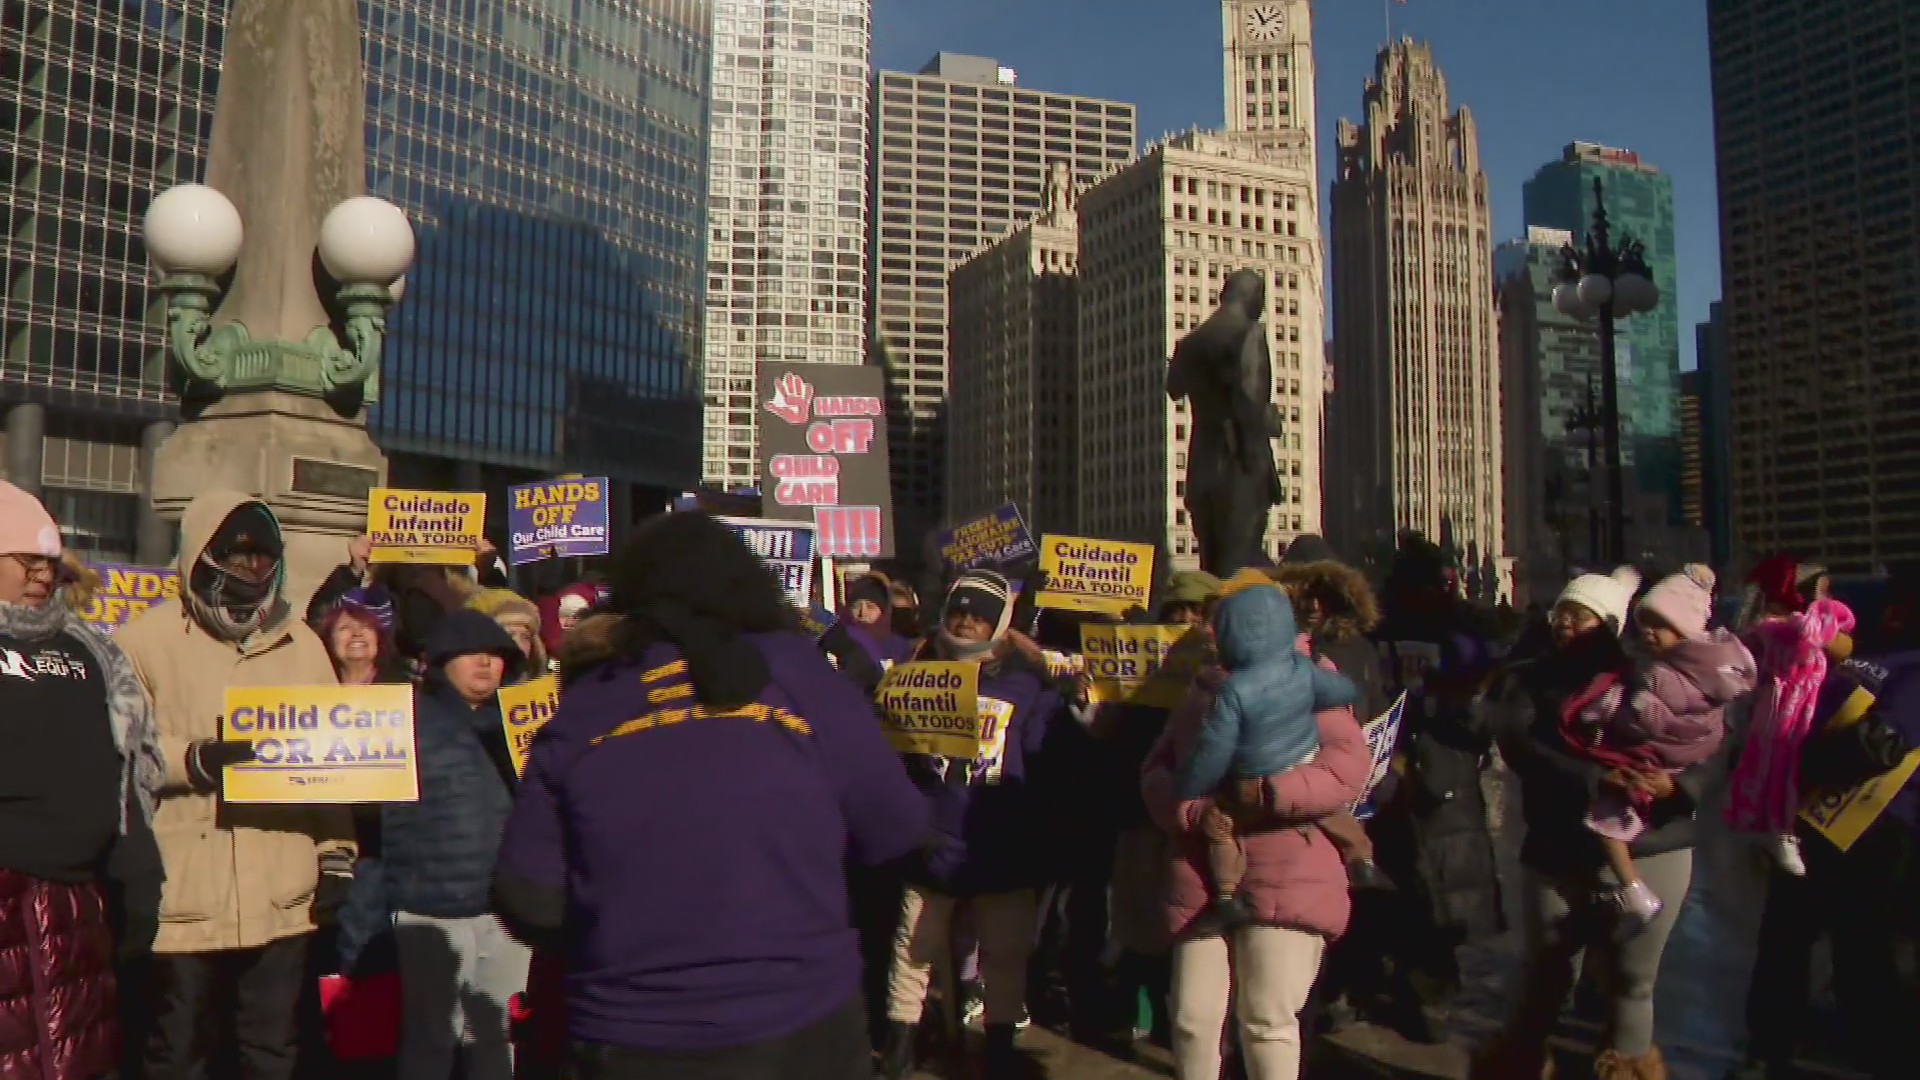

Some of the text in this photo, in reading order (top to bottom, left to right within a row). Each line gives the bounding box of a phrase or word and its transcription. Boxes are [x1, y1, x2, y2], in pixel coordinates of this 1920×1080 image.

[814, 397, 881, 416] HANDS
[806, 419, 874, 453] OFF
[770, 455, 839, 478] CHILD
[515, 483, 599, 509] HANDS
[775, 481, 838, 505] CARE
[384, 494, 471, 514] Cuidado
[389, 514, 463, 532] Infantil
[531, 504, 576, 527] OFF
[372, 531, 478, 545] PARA TODOS
[513, 524, 604, 545] Our Child Care
[1055, 542, 1138, 565] Cuidado
[1059, 560, 1131, 583] Infantil
[1090, 581, 1145, 597] TODOS
[1085, 636, 1138, 655] Child
[1087, 658, 1137, 677] FOR
[883, 691, 957, 712] Infantil
[231, 702, 406, 732] Child Care
[917, 715, 975, 731] TODOS
[254, 738, 407, 764] OR ALL
